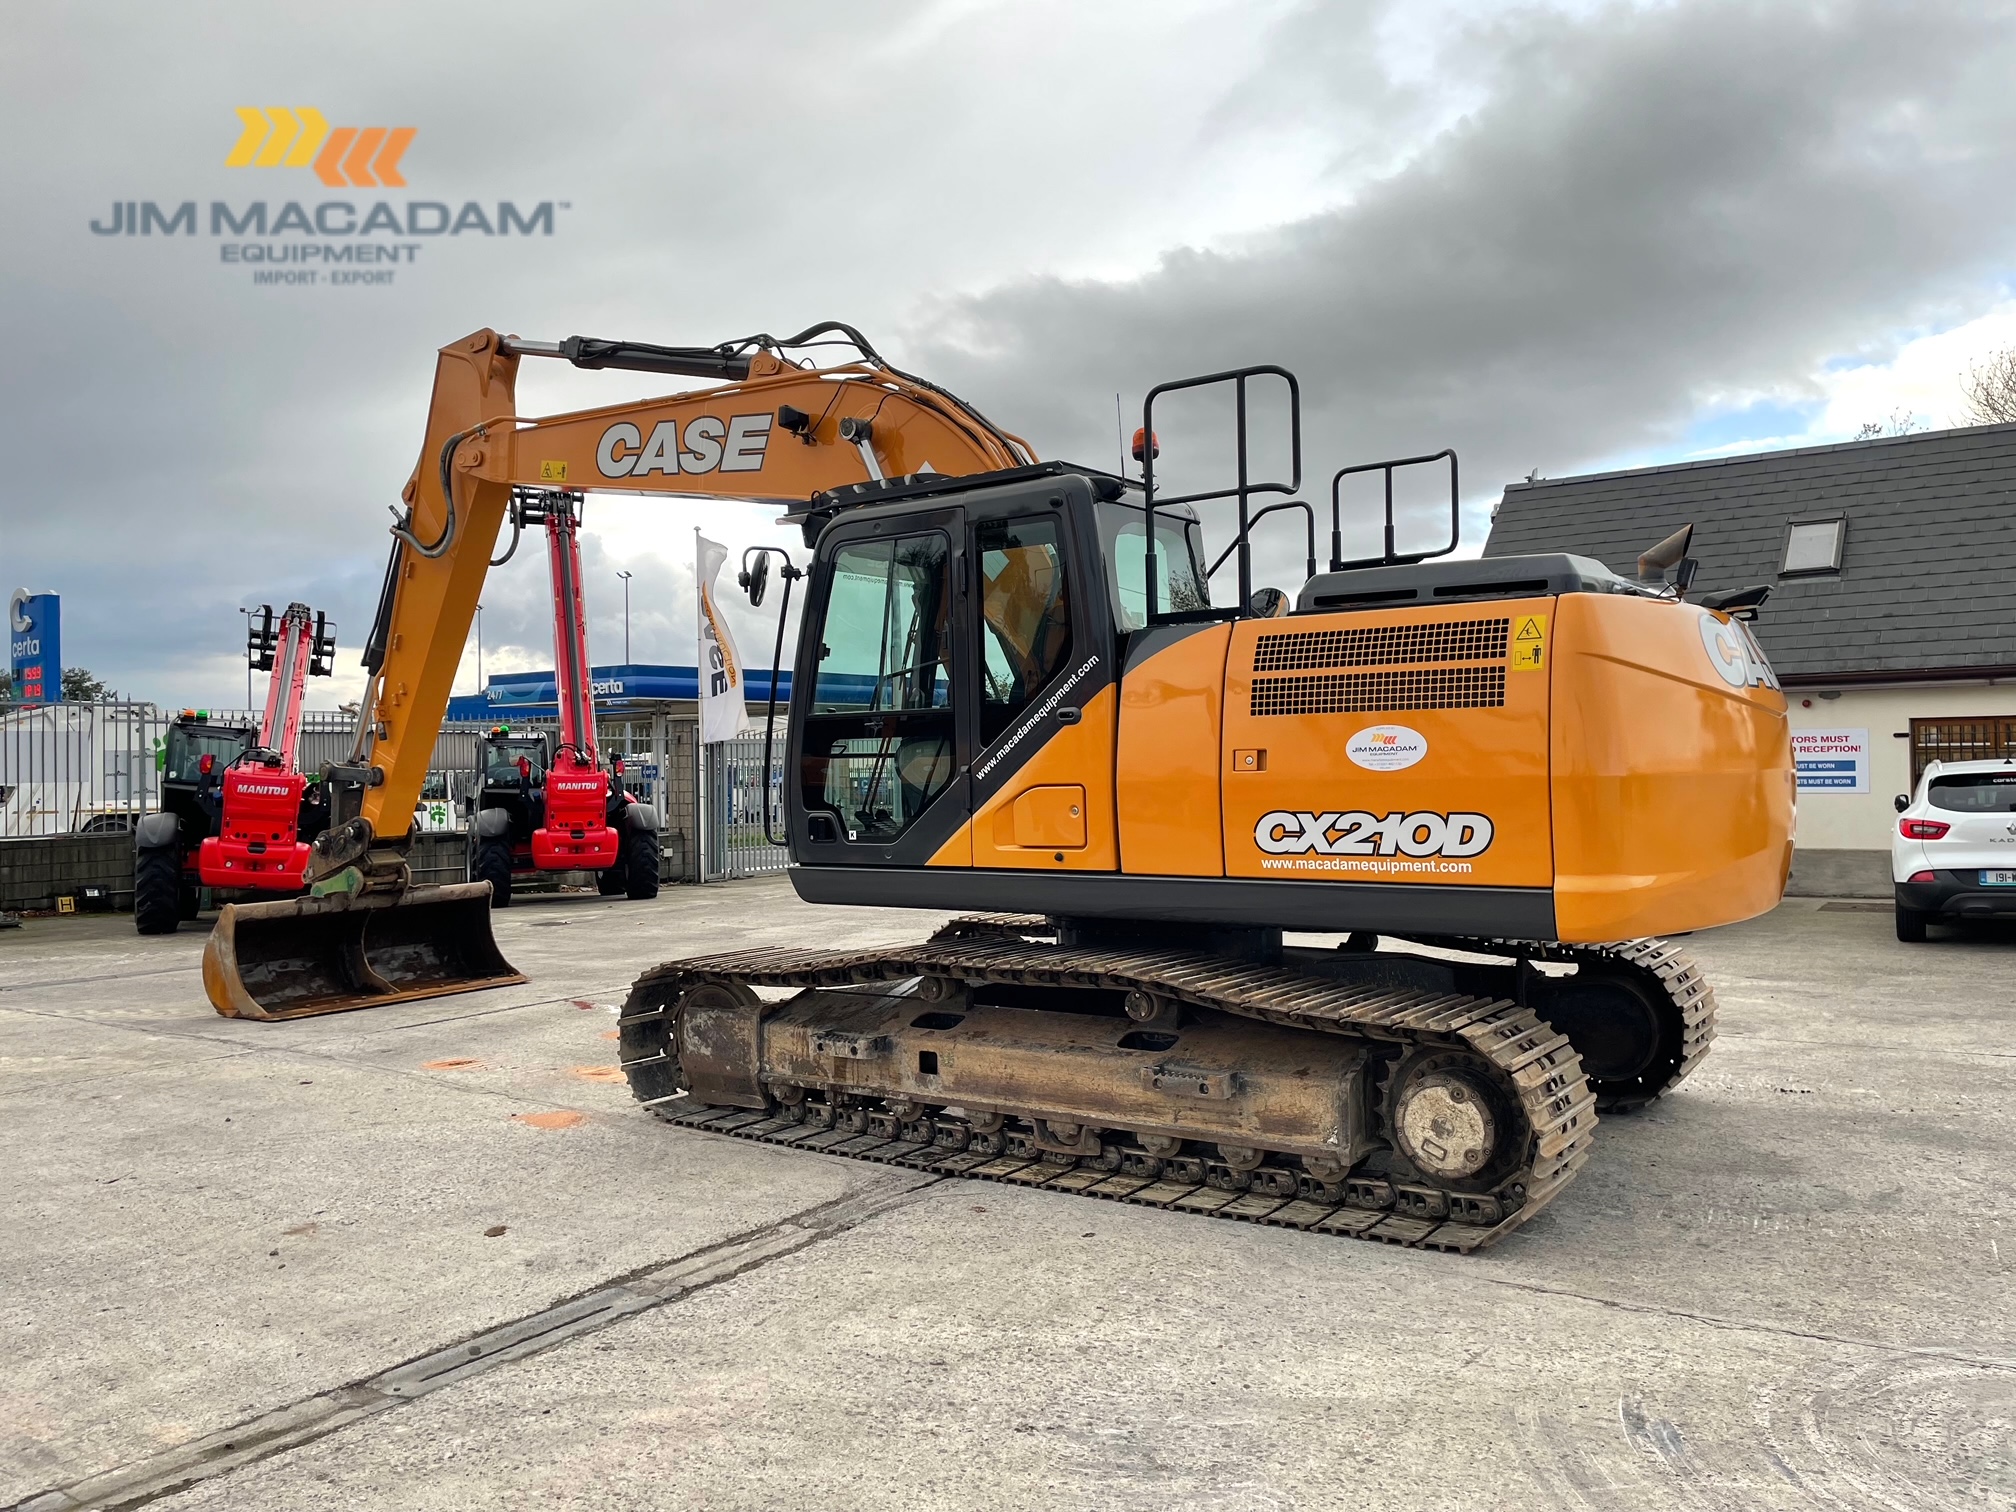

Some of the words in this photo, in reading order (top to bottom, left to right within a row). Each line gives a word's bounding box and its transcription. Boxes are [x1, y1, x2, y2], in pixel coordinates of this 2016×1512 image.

[596, 412, 774, 479] CASE
[12, 636, 40, 658] certa
[592, 679, 624, 695] certa
[976, 655, 1100, 780] www.macadamequipment.com
[1820, 735, 1849, 743] MUST
[1368, 745, 1417, 753] MACADAM
[1799, 745, 1861, 753] RECEPTION!
[237, 784, 289, 796] MANITOU
[557, 782, 598, 791] MANITOU
[1254, 810, 1495, 858] CX210D
[1261, 858, 1472, 874] www.macadamequipment.com
